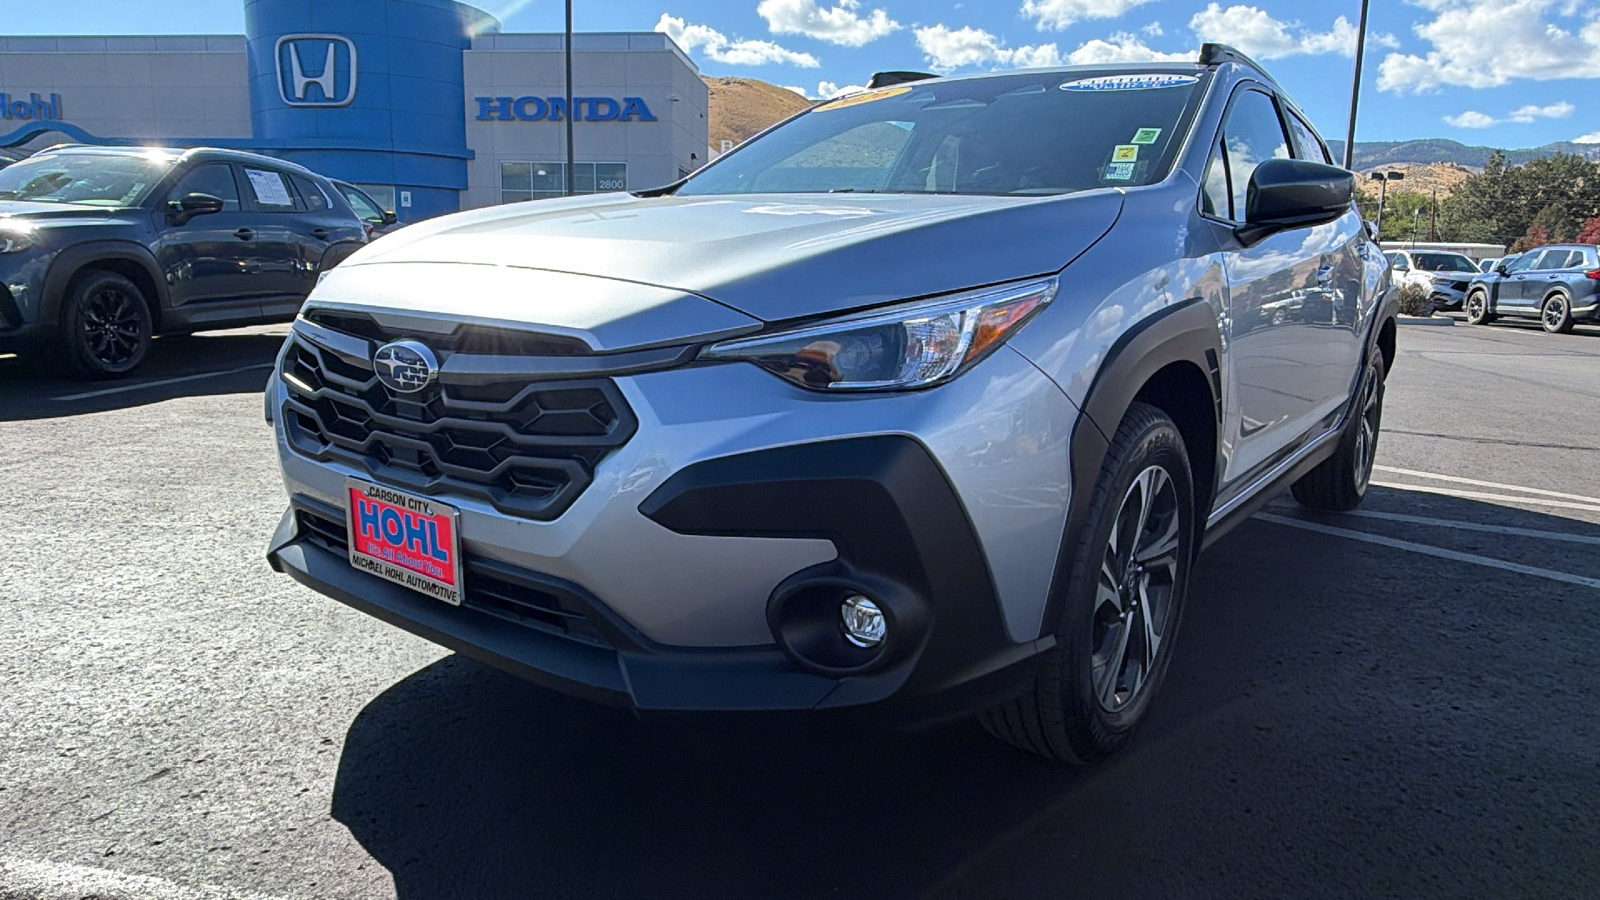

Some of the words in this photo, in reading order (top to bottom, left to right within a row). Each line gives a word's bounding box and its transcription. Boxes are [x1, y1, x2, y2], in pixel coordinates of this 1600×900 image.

[475, 96, 658, 121] HONDA
[599, 180, 624, 189] 2800
[369, 486, 406, 507] CARSON
[408, 498, 430, 513] CITY
[358, 499, 448, 562] HOHL
[382, 547, 394, 561] All
[396, 552, 423, 569] About
[352, 555, 384, 574] MICHAEL
[385, 567, 405, 583] HOHL
[406, 575, 458, 602] AUTOMOTIVE
